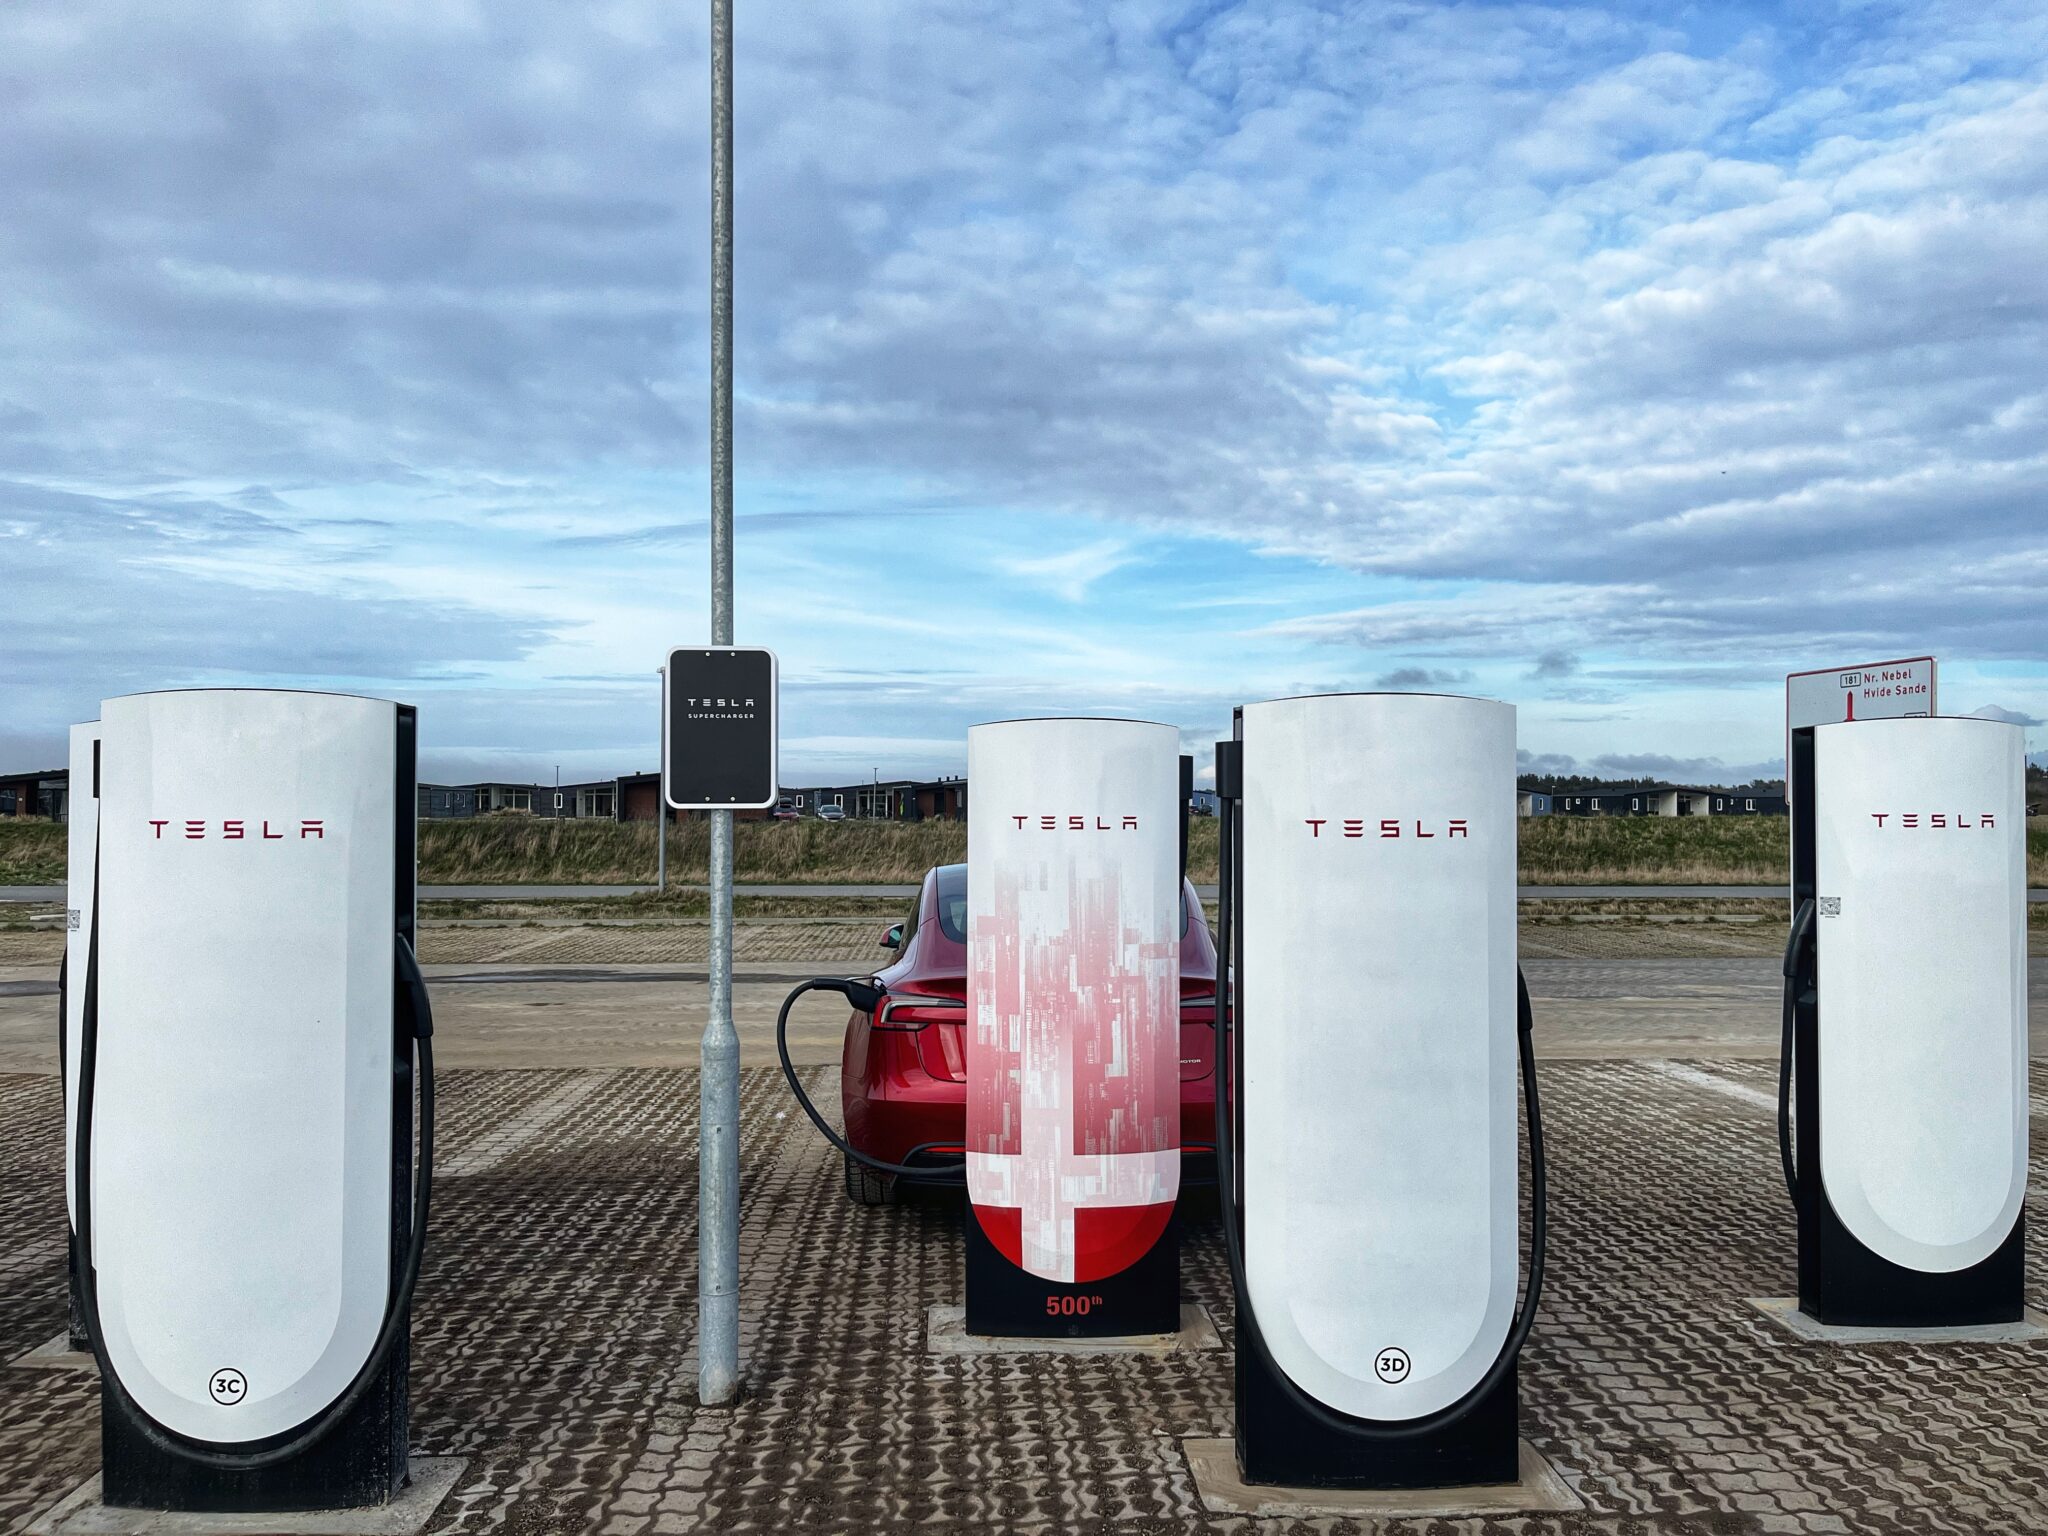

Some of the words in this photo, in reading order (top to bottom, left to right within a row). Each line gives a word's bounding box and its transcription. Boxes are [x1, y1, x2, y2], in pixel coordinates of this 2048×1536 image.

[1845, 676, 1857, 685] 181
[1864, 673, 1877, 683] Nr.
[1882, 669, 1912, 681] Nebel
[1864, 688, 1891, 698] Hvide
[1895, 684, 1927, 695] Sande
[1012, 816, 1137, 830] TESLA
[1305, 820, 1467, 838] TESLA
[1871, 814, 1994, 828] TESLA
[149, 820, 324, 839] TESLA
[1046, 1296, 1103, 1315] 500th
[1380, 1357, 1405, 1372] 3D
[215, 1378, 241, 1394] 3C
